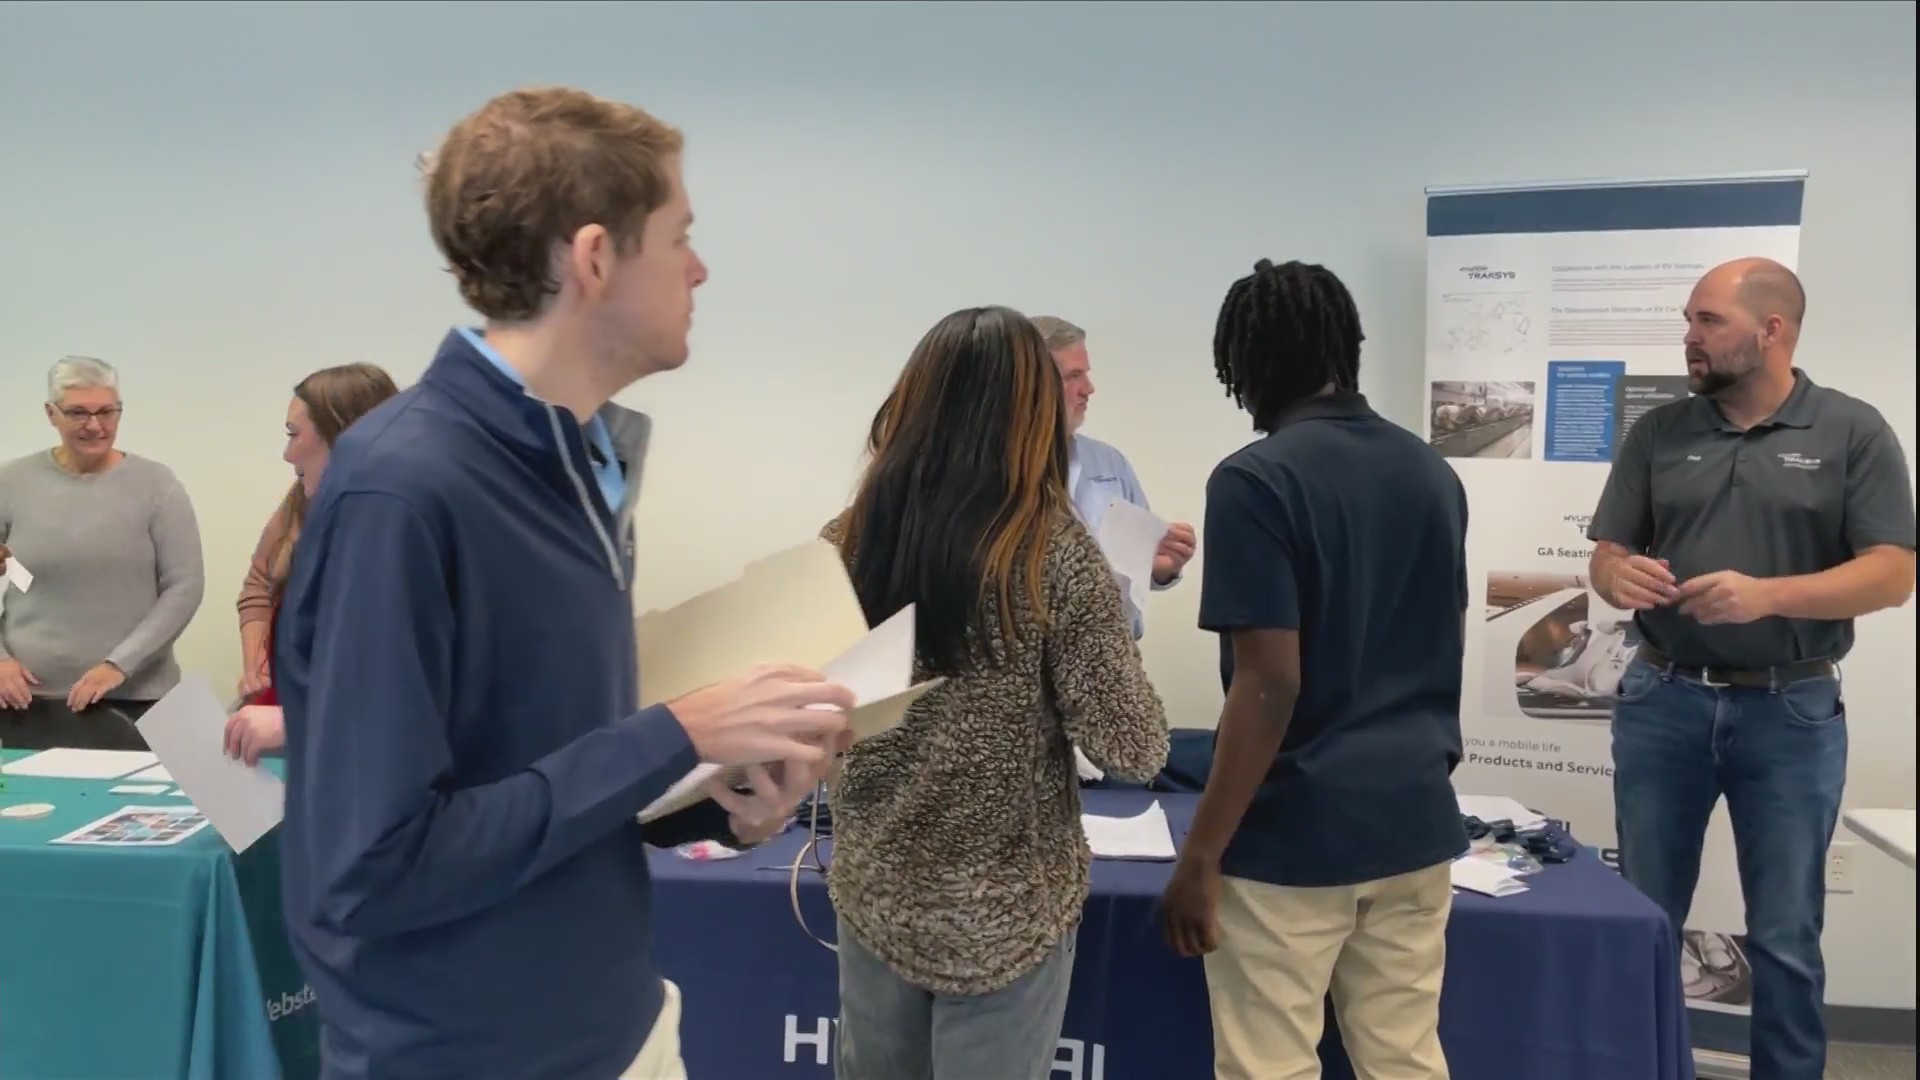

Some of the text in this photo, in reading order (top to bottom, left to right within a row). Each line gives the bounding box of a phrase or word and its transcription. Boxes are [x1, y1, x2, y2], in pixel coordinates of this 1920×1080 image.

[1537, 547, 1595, 558] GA Seatin
[1464, 737, 1562, 753] you a mobile life
[1469, 753, 1613, 777] Products and Servic
